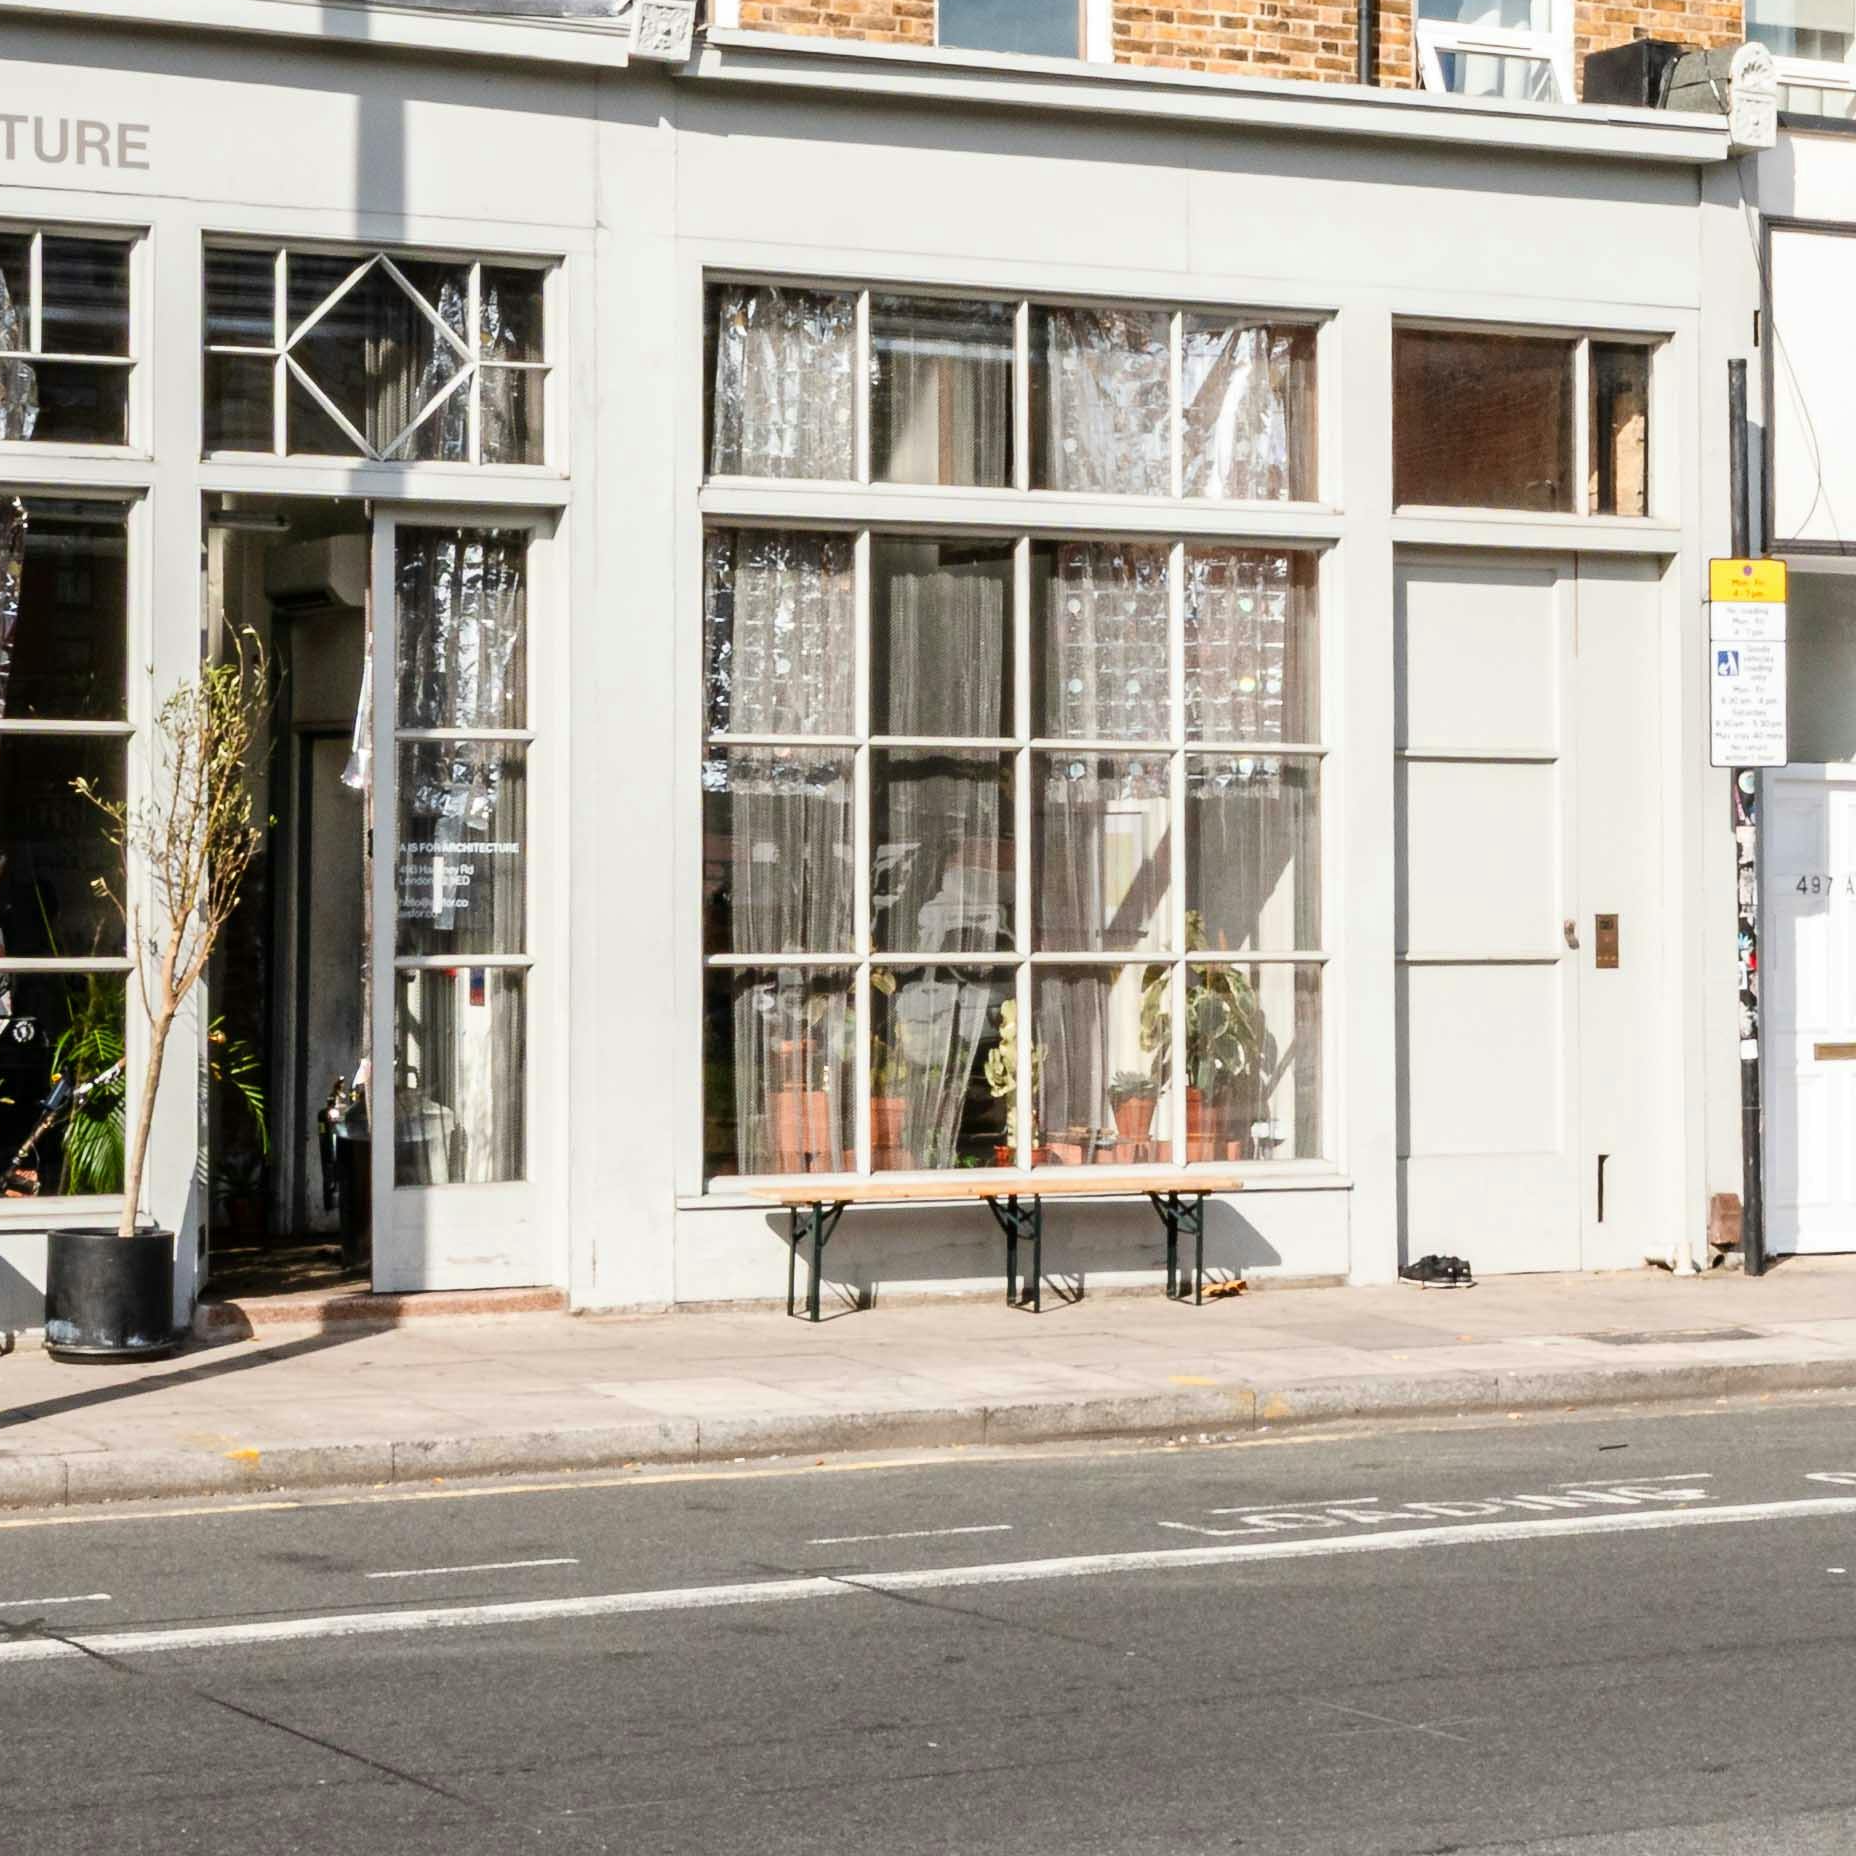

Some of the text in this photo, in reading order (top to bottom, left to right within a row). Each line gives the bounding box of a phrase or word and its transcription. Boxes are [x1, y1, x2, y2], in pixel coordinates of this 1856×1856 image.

[442, 842, 520, 854] ARCHITECTURE
[1795, 874, 1834, 897] 497
[1160, 1485, 1720, 1537] LOADING
